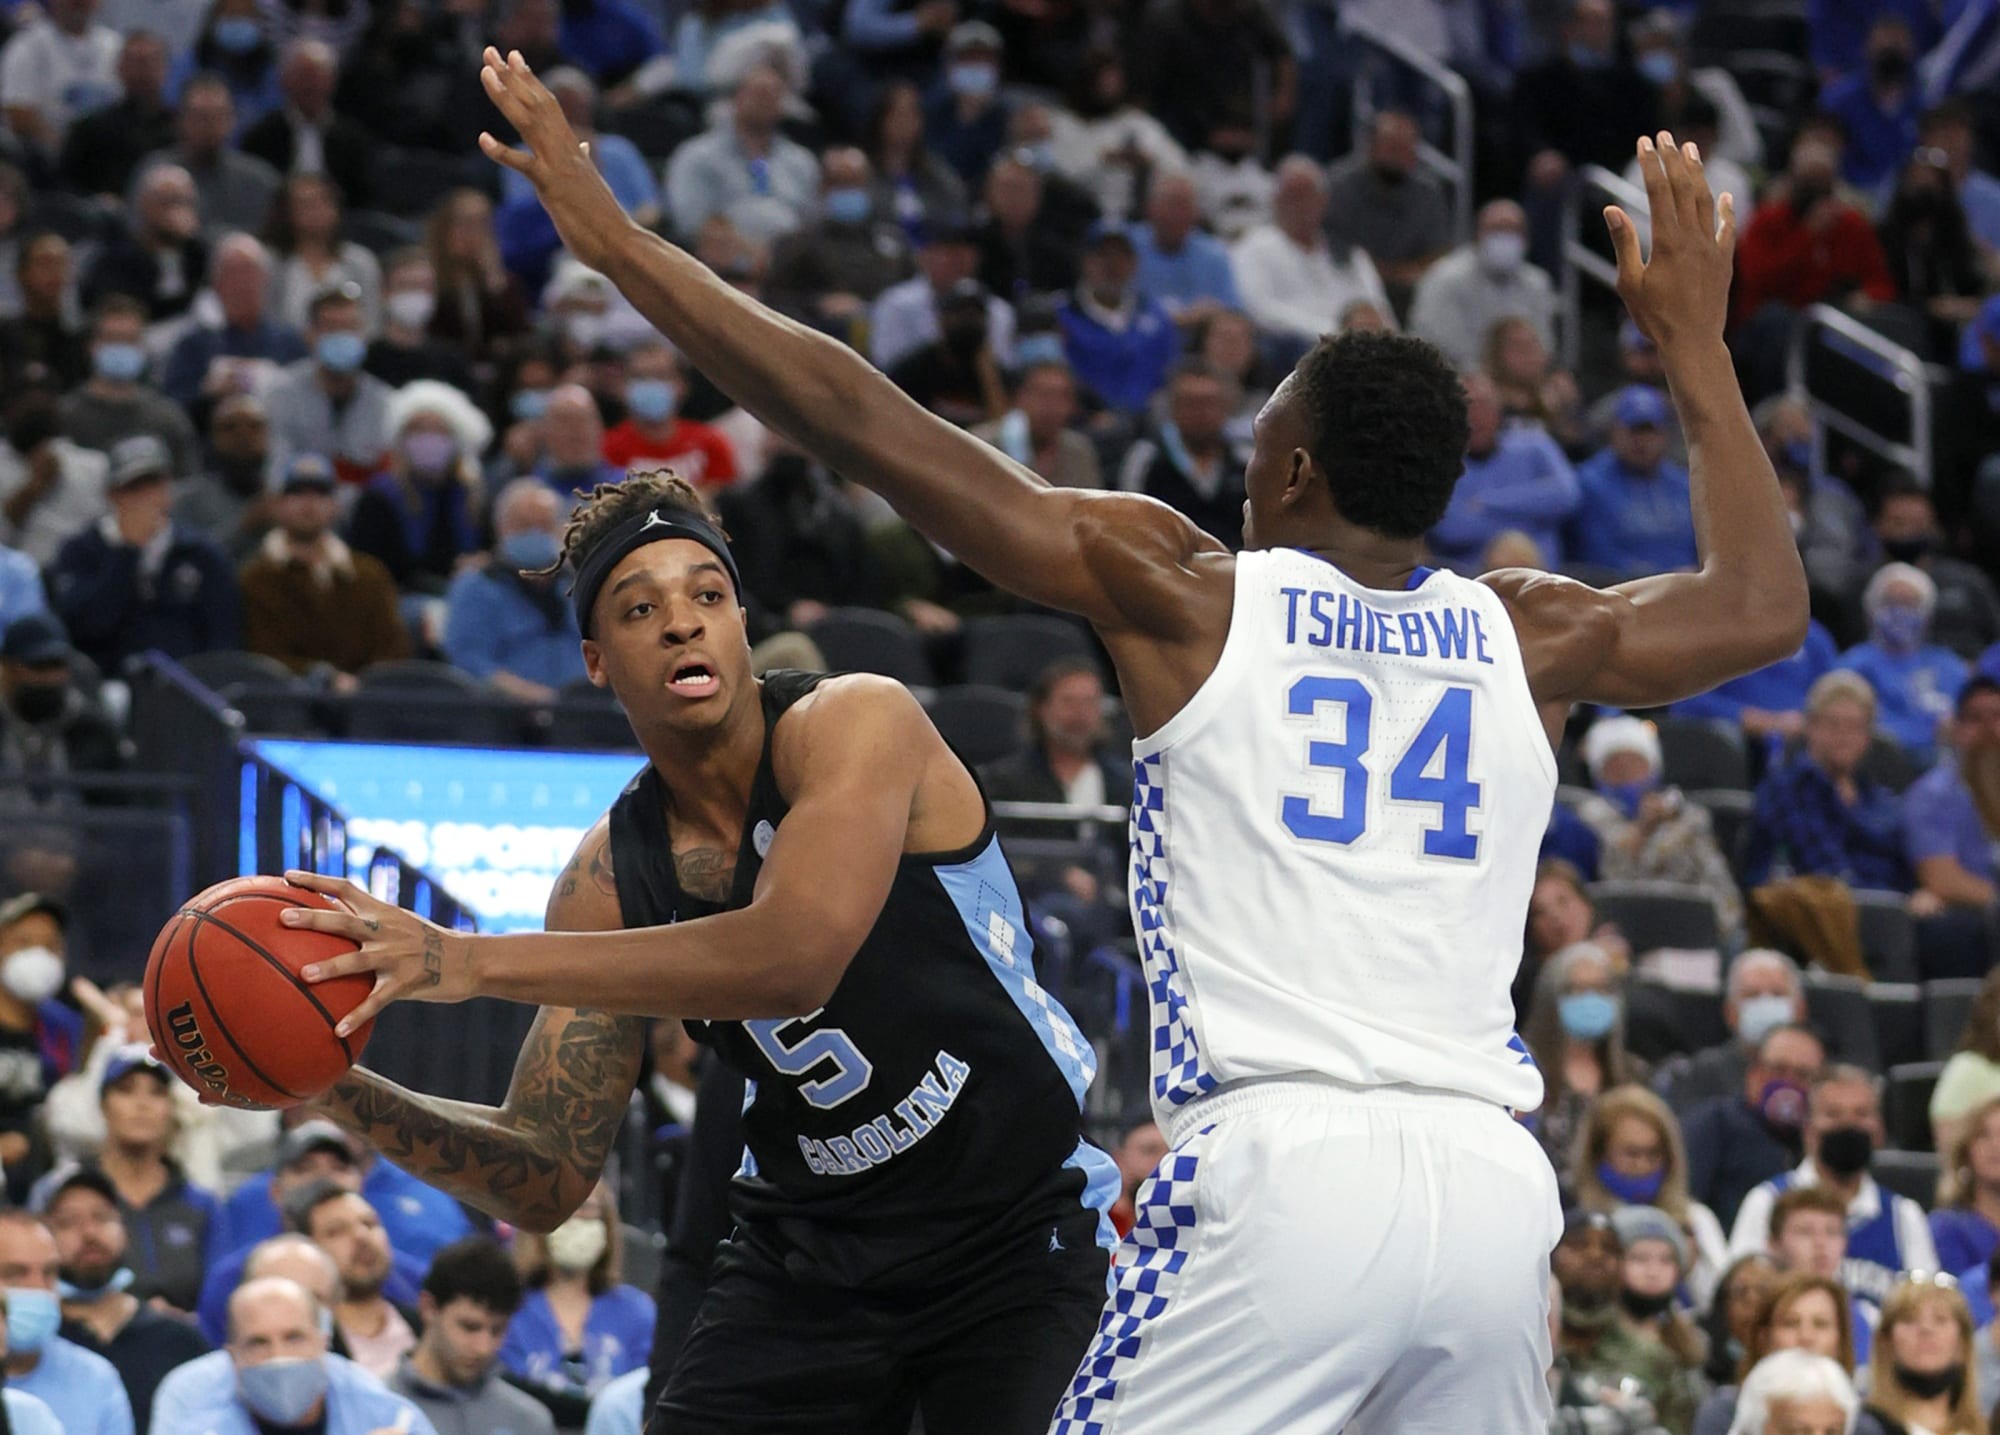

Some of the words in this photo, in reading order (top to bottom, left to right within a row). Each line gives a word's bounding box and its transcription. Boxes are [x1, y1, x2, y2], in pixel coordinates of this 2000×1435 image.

[1280, 587, 1494, 665] TSHIEBWE
[1276, 670, 1484, 866] 34
[167, 999, 272, 1109] Wils
[742, 1007, 873, 1110] 5
[797, 1050, 971, 1175] CAROLINA
